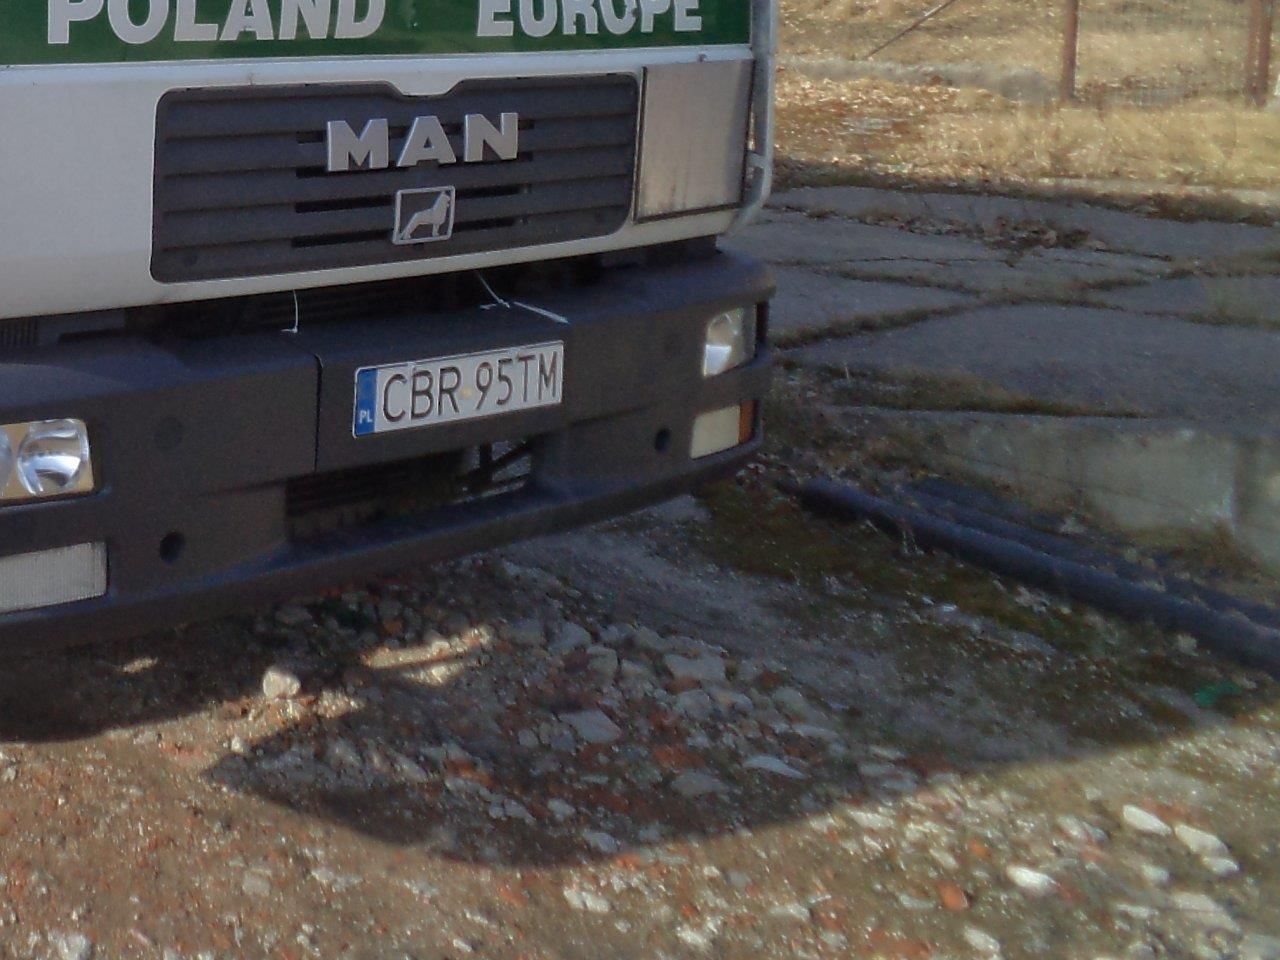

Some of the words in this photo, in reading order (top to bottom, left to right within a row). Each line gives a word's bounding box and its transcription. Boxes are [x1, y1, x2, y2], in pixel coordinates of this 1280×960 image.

[326, 112, 519, 172] MAN
[358, 409, 374, 424] PL
[382, 366, 460, 423] CBR
[475, 350, 558, 411] 95TM
